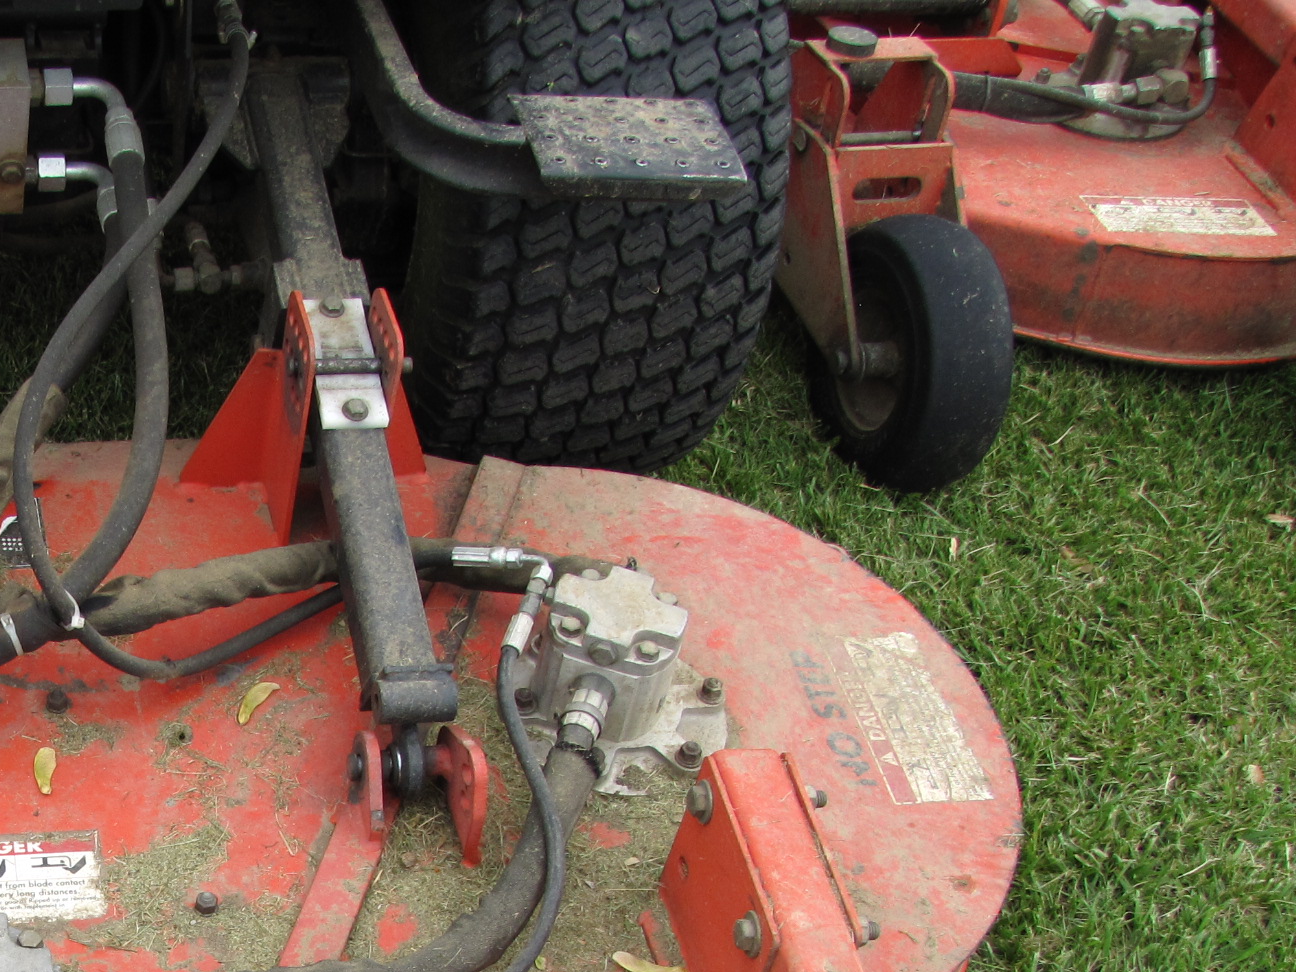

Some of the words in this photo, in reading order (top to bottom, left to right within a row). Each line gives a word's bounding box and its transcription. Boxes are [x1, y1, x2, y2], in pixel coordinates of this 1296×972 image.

[5, 880, 25, 889] from
[28, 878, 52, 887] blade
[16, 889, 35, 898] long
